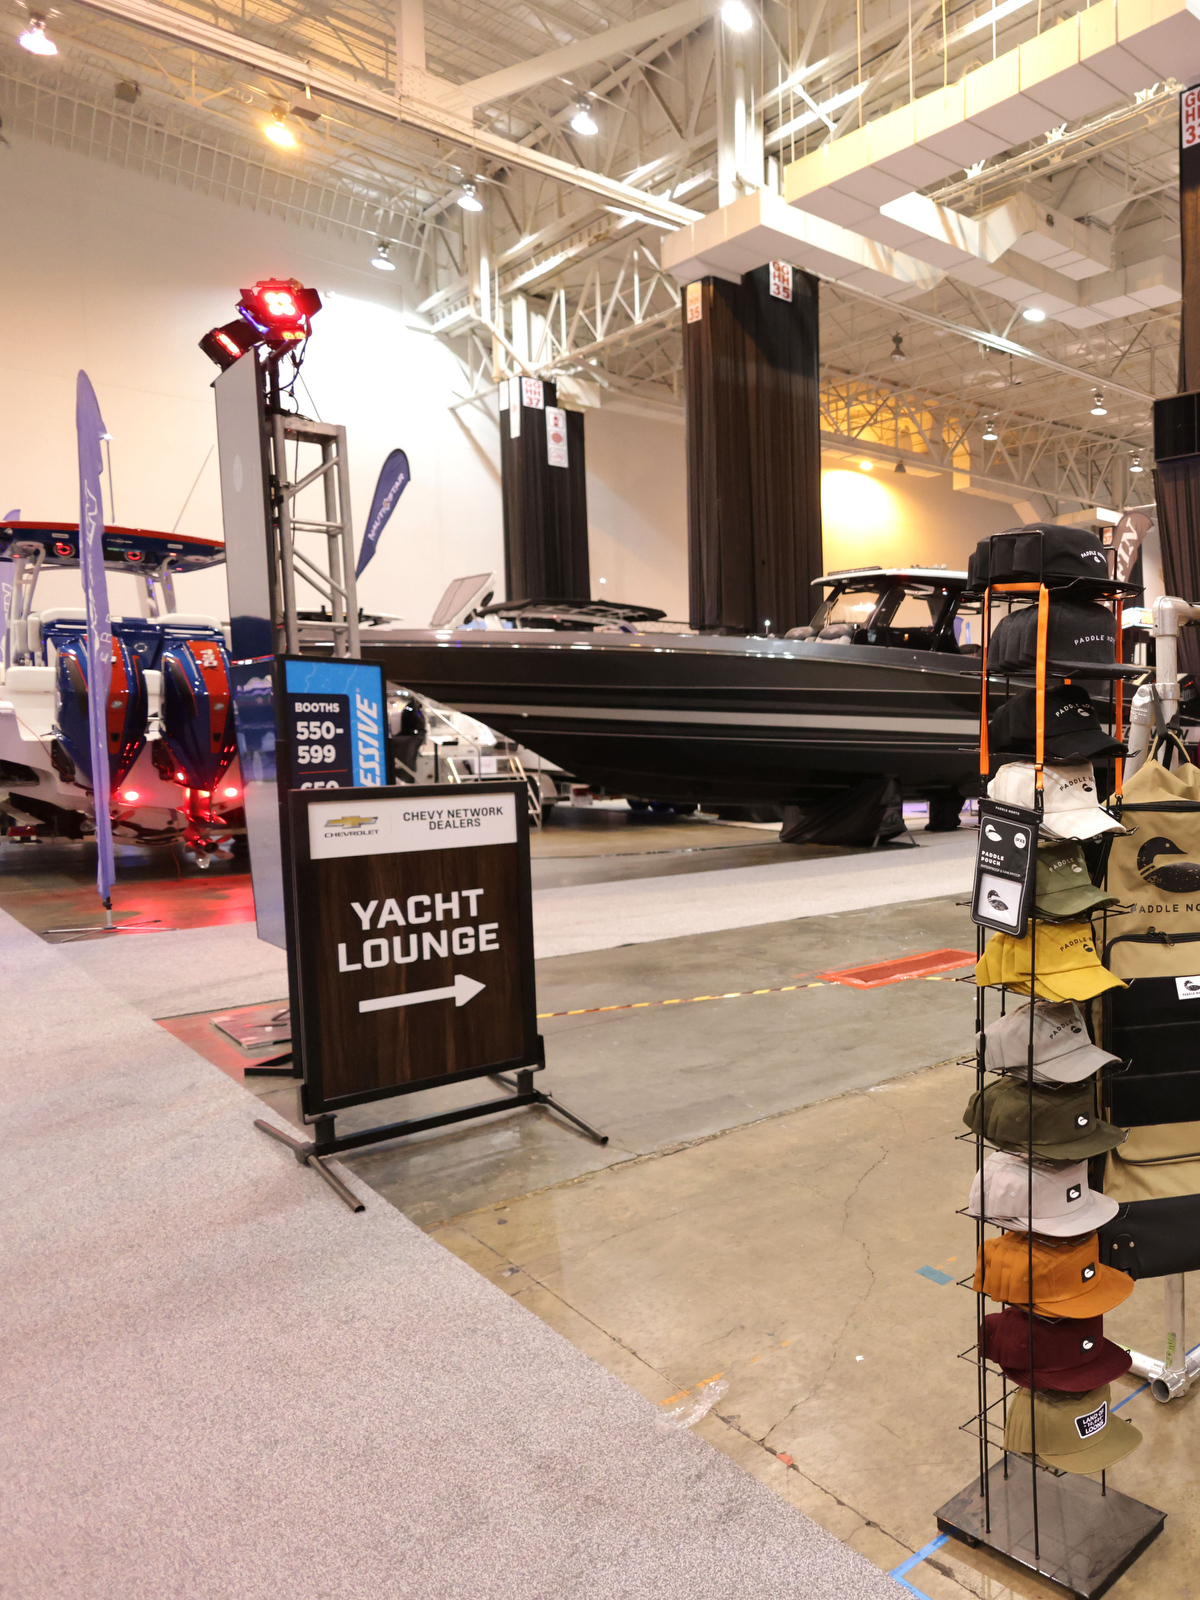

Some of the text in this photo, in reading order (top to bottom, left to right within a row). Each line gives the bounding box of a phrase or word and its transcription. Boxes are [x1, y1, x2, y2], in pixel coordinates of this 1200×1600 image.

[773, 283, 790, 299] 35
[688, 306, 700, 321] 35
[526, 396, 541, 407] 37
[1080, 550, 1097, 559] PADDLE
[1074, 634, 1105, 646] PADDLE
[294, 702, 341, 714] BOOTHS
[1055, 703, 1080, 718] PADDLE
[296, 720, 344, 741] 550-
[297, 744, 337, 765] 599
[1059, 776, 1087, 792] PADDLE
[402, 806, 504, 823] CHEVY NETWORK
[995, 805, 1008, 813] PADDLE
[428, 817, 482, 831] DEALERS
[323, 829, 380, 838] CHEVROLET
[980, 856, 1001, 867] POUCH
[981, 850, 1005, 861] PADDLE
[1048, 857, 1075, 873] PADDLE
[351, 888, 485, 931] YACHT
[337, 922, 500, 973] LOUNGE
[1059, 936, 1087, 952] PADDLE
[1049, 1018, 1074, 1040] PADDLE
[1082, 1413, 1098, 1425] LAND
[1085, 1419, 1104, 1434] LOONS
